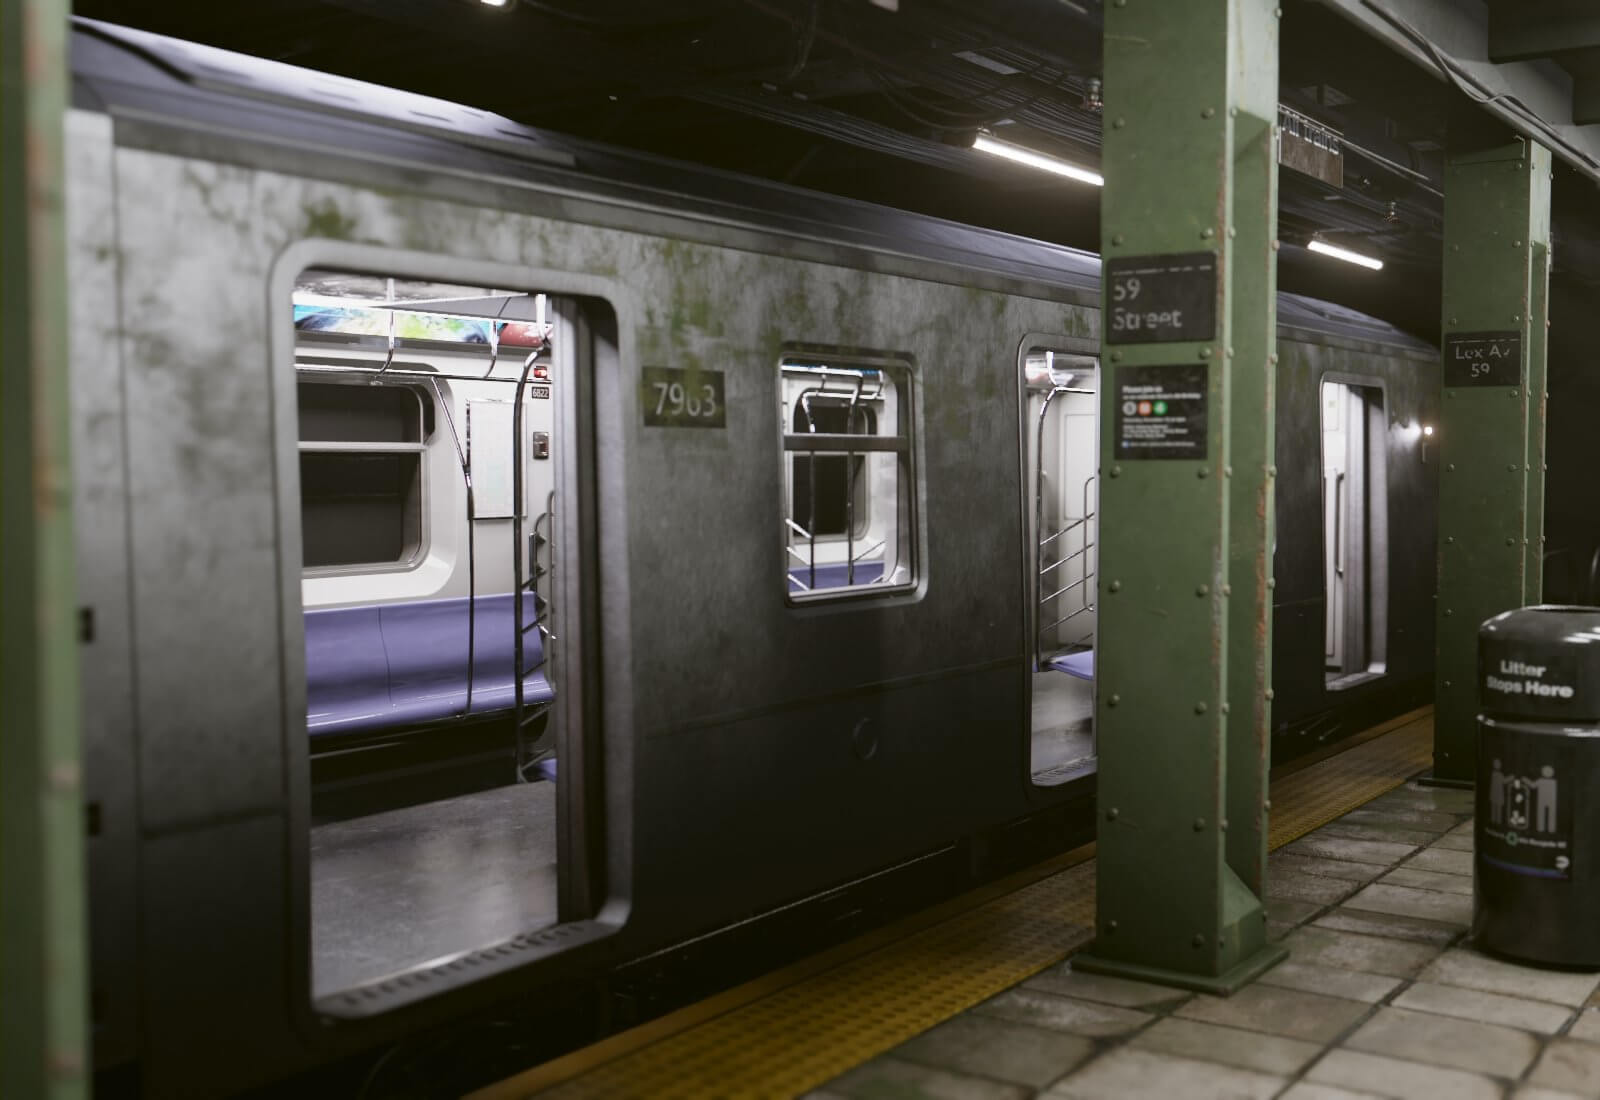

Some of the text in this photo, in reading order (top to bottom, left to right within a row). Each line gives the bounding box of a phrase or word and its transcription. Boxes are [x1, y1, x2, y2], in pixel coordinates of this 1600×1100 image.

[1112, 306, 1183, 331] Street
[1471, 362, 1490, 378] 59
[532, 388, 550, 398] 6822
[1500, 659, 1548, 678] Litter
[1524, 680, 1575, 699] Here
